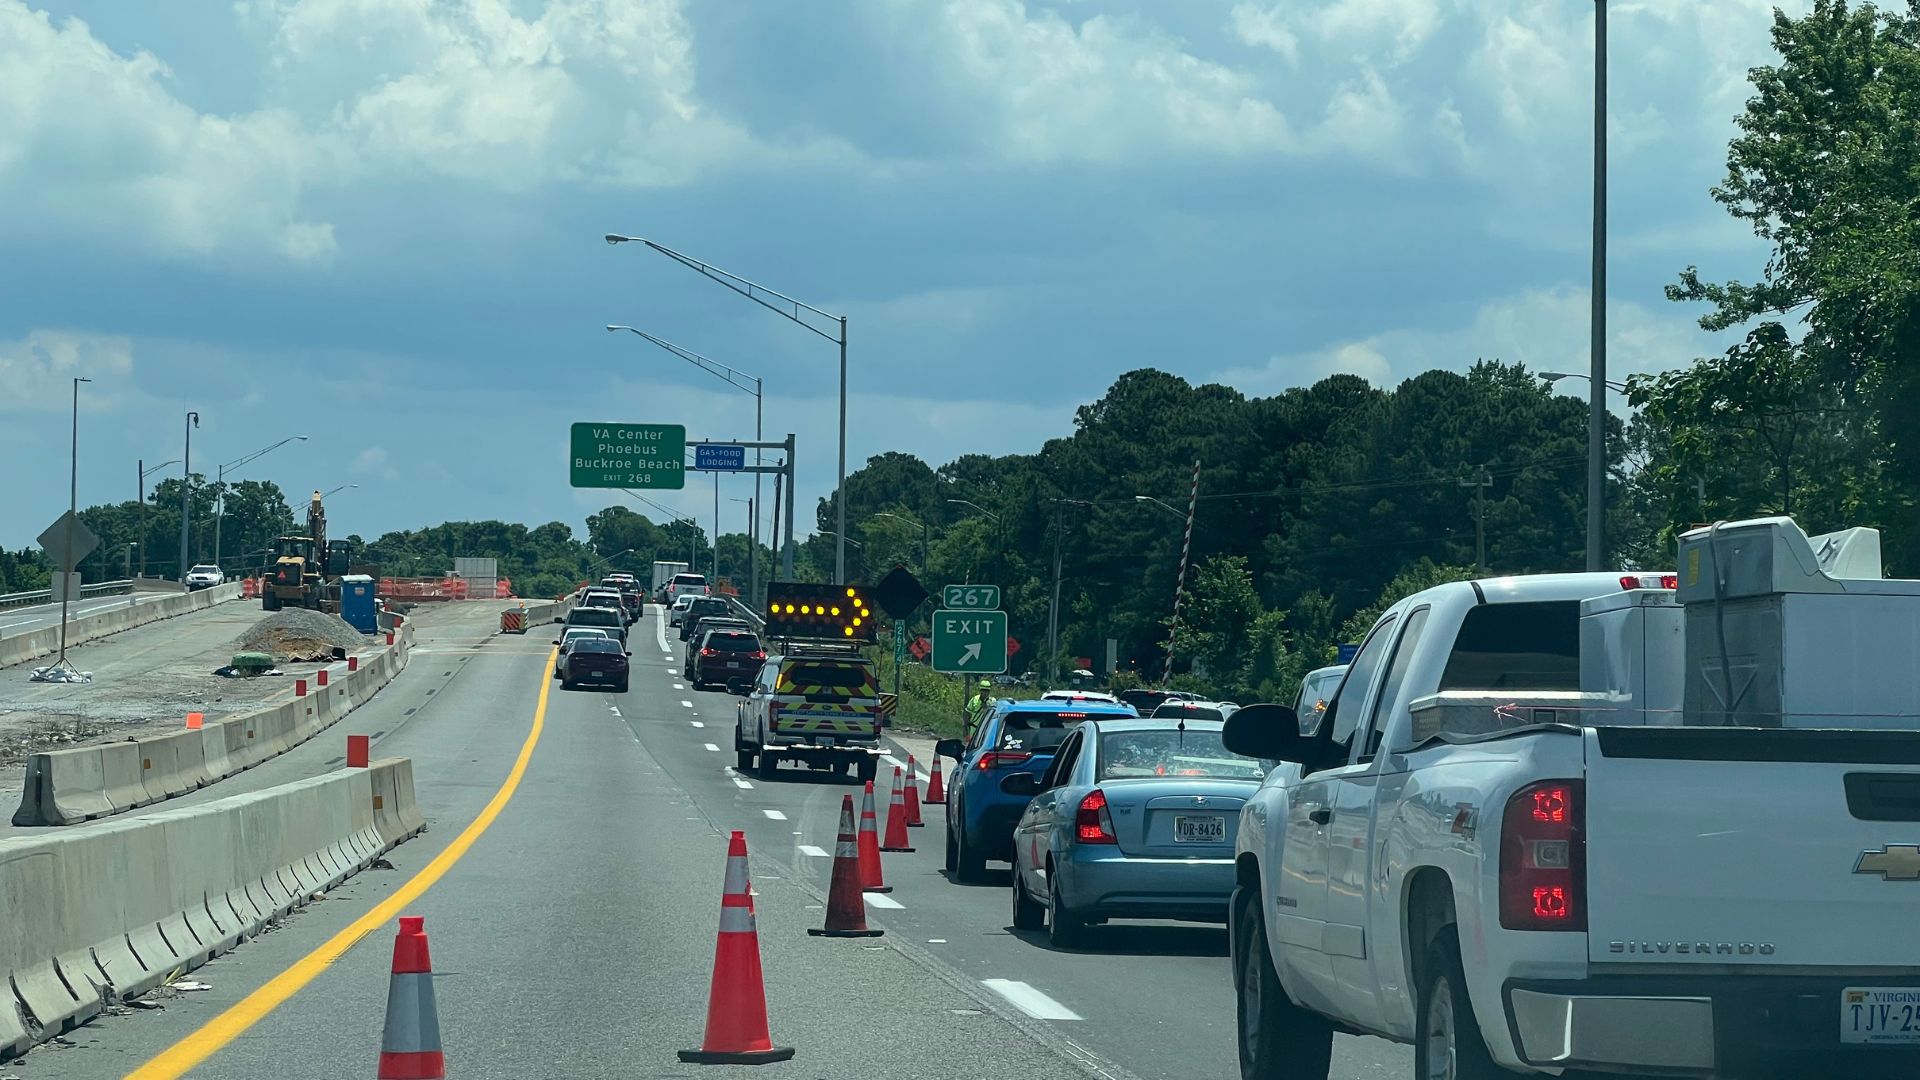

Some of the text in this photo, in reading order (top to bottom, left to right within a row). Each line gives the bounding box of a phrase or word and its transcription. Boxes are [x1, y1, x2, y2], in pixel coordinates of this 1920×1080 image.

[593, 429, 663, 440] VA Center
[598, 443, 657, 455] Phoebus
[699, 449, 741, 457] GAS-FOOD
[575, 458, 680, 470] Buckroe Beach
[702, 459, 738, 467] LODGING
[628, 473, 651, 483] 268
[949, 588, 994, 606] 267
[946, 620, 993, 634] EXIT
[1178, 823, 1222, 836] VDR-8426
[1609, 941, 1775, 955] SILVERADO
